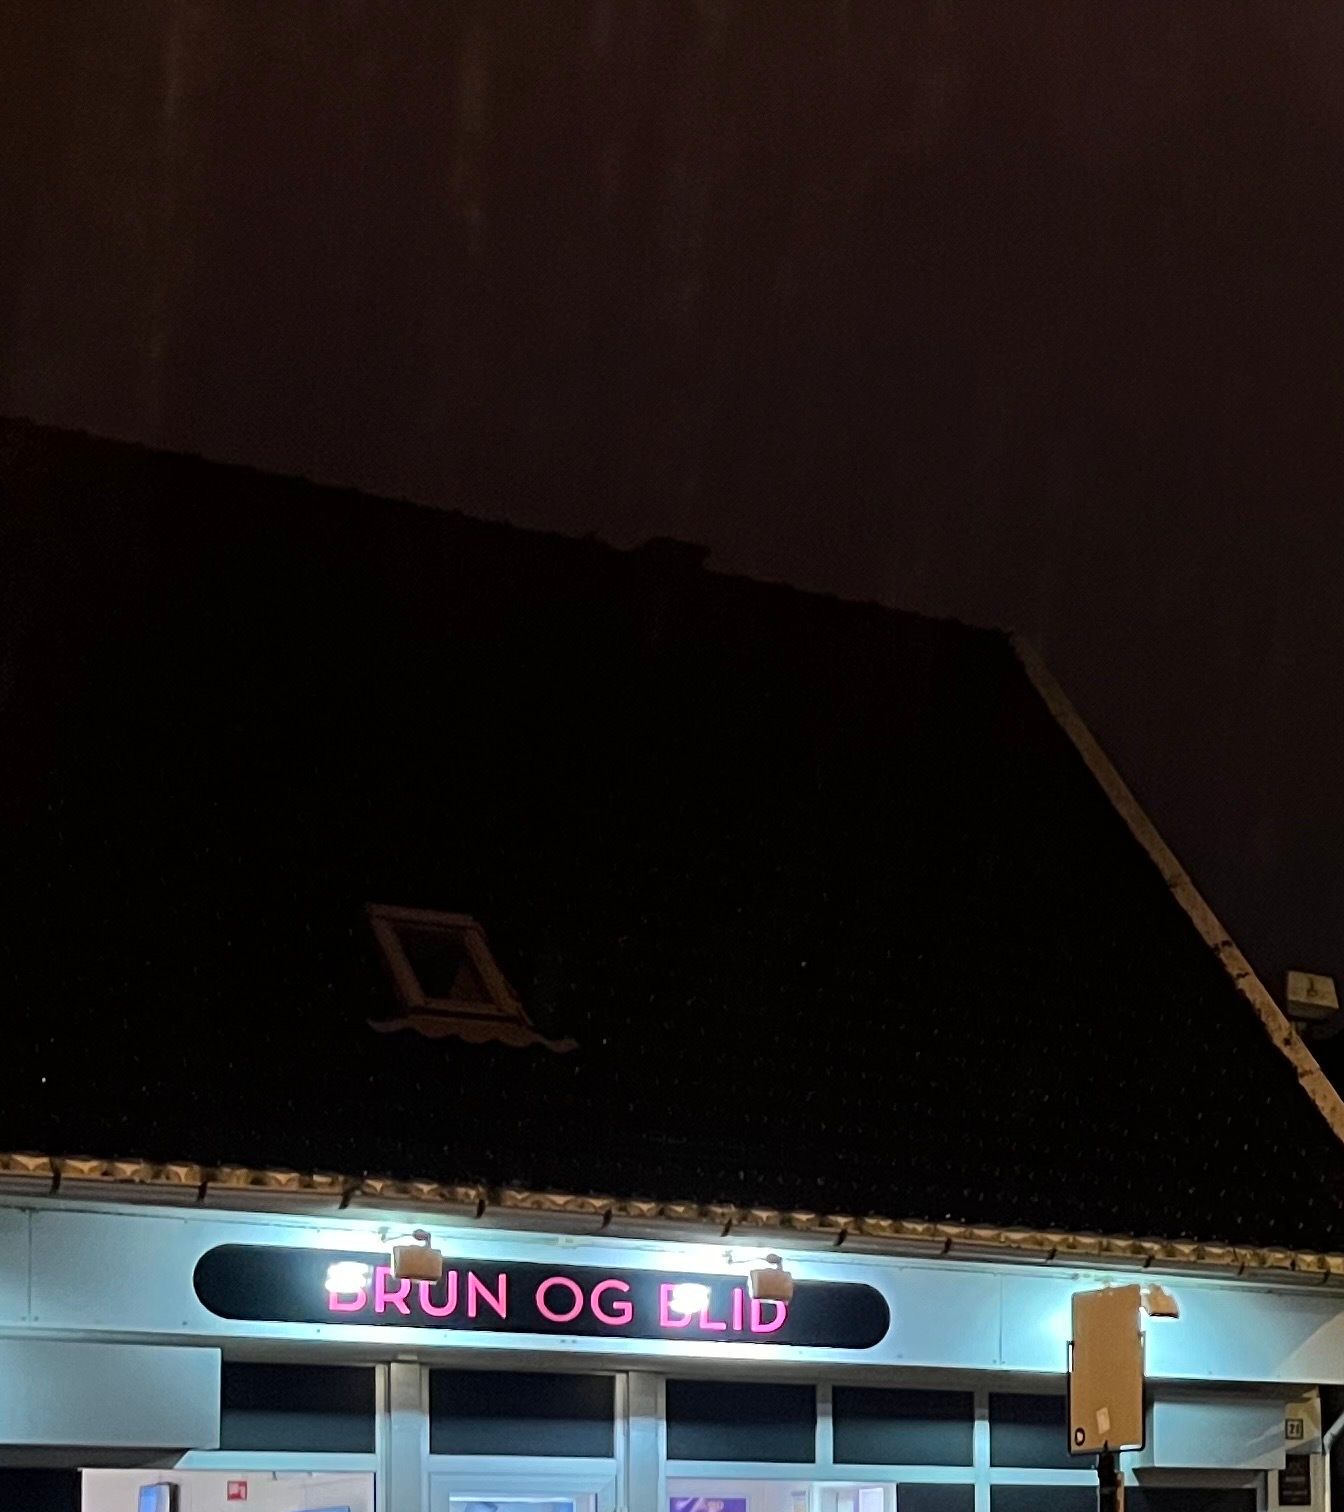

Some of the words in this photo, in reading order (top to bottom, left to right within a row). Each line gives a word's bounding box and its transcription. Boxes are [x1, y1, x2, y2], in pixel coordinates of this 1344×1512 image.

[327, 1264, 507, 1319] BRUN
[536, 1276, 633, 1327] OG
[658, 1282, 788, 1333] BLID
